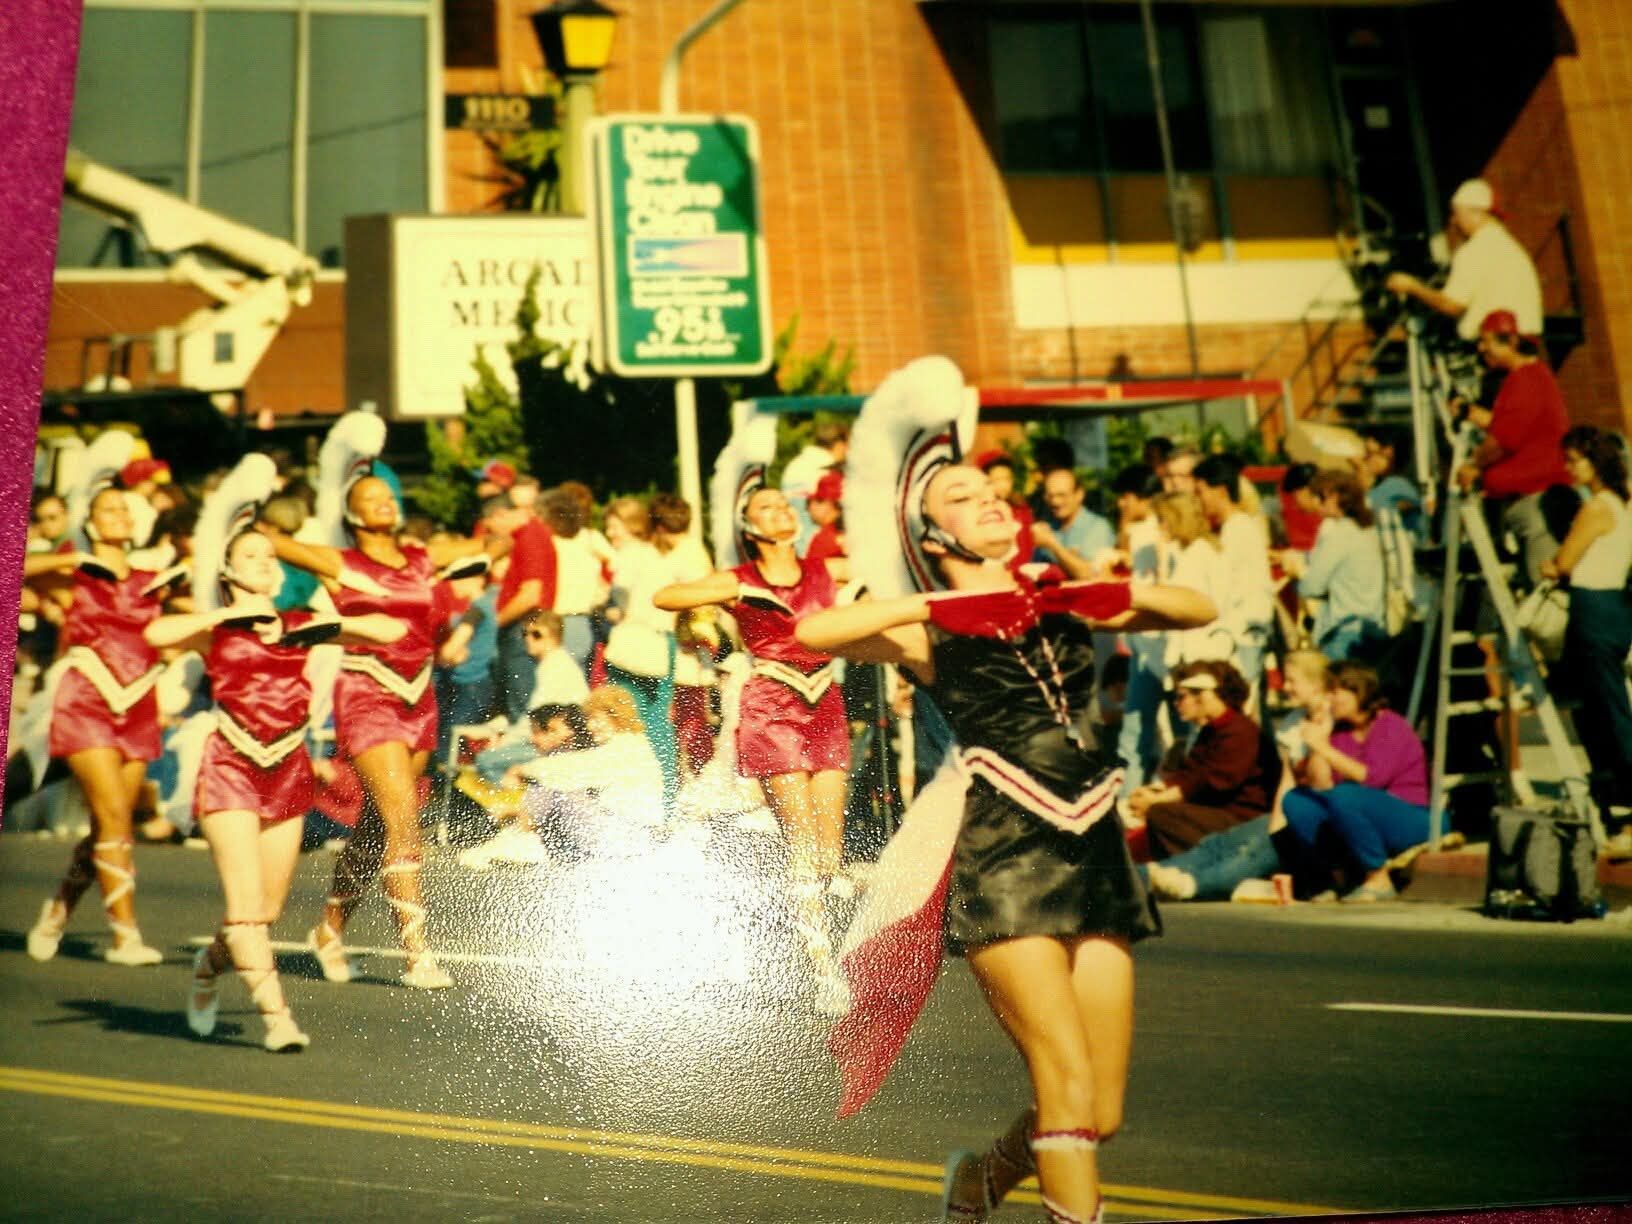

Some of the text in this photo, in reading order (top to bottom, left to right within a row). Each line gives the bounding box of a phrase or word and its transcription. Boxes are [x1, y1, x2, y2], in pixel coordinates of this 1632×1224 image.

[463, 96, 529, 119] 1110
[623, 126, 699, 157] Drive
[625, 180, 722, 212] Engine
[447, 299, 579, 328] MEIC
